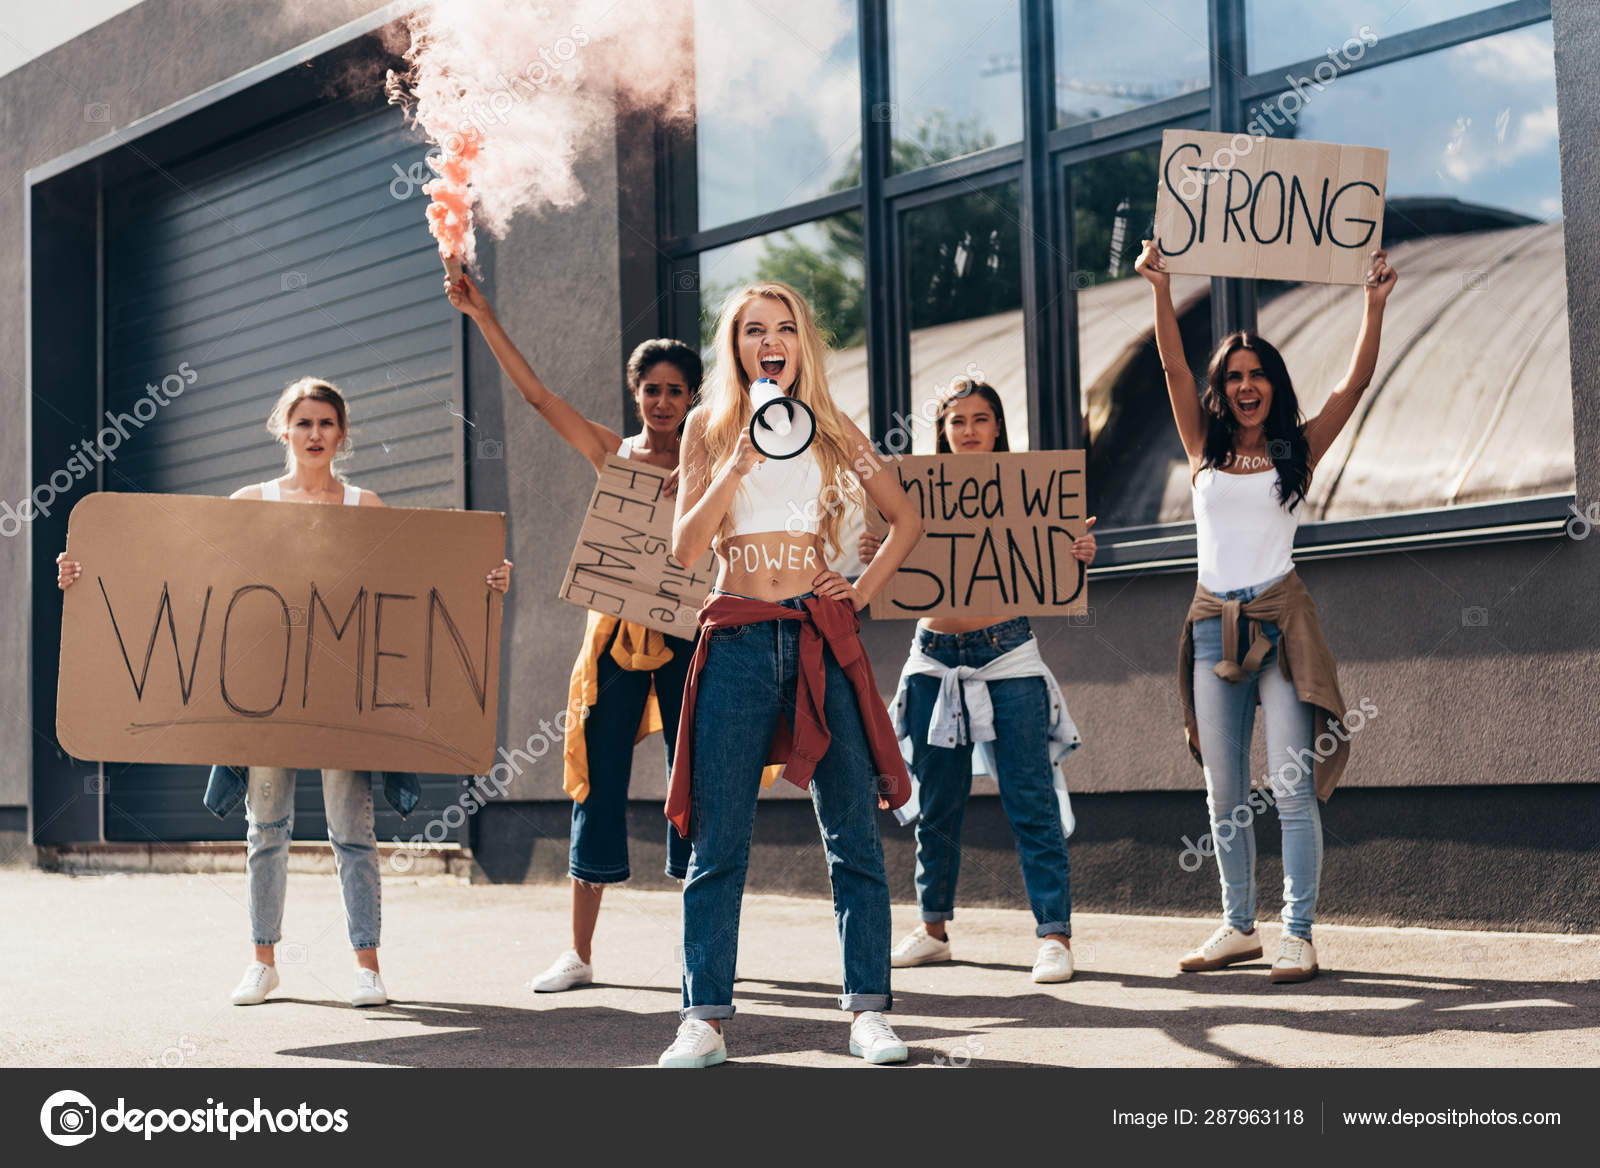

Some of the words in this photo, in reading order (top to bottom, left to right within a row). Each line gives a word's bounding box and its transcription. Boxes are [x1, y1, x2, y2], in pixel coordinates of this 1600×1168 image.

[1158, 143, 1380, 257] STRONG
[879, 462, 1004, 521] nited
[1021, 469, 1081, 519] WE
[566, 464, 665, 616] FEMALE
[729, 543, 817, 573] POWER
[649, 554, 706, 623] uture
[98, 576, 492, 717] WOMEN
